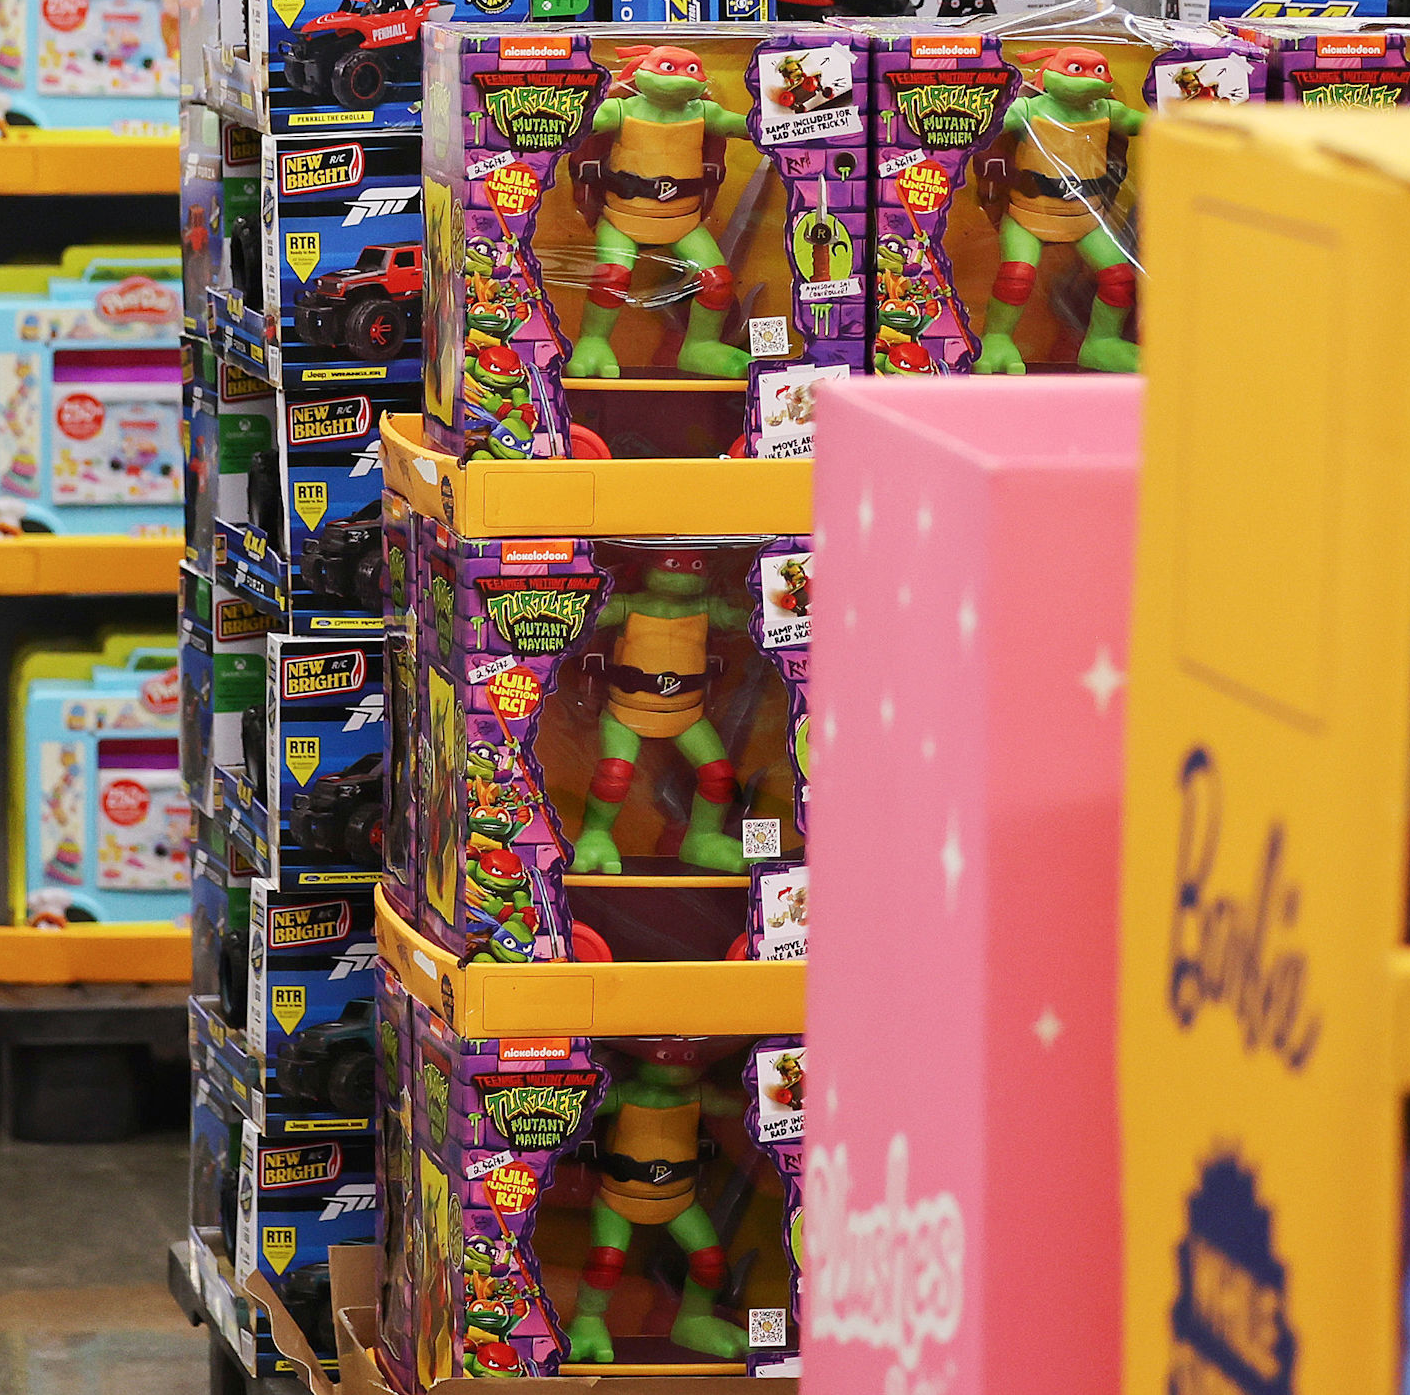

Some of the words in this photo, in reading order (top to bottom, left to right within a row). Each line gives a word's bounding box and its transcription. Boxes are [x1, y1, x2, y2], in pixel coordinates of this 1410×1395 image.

[504, 46, 566, 57] nickelodeon
[916, 45, 977, 56] nickelodeon
[1321, 44, 1381, 54] nickelodeon
[327, 114, 339, 123] THE
[340, 113, 365, 122] CHOLLA
[485, 86, 589, 137] TURTLES
[896, 85, 999, 136] TURTLES
[512, 116, 566, 134] MUTANT
[765, 122, 790, 135] RAMP
[793, 112, 833, 129] INCLUDED
[792, 123, 816, 137] SKATE
[923, 114, 977, 132] MUTANT
[516, 134, 562, 149] MAYHEM
[927, 131, 973, 146] MAYHEM
[285, 154, 323, 173] NEW
[329, 154, 346, 165] R/C
[286, 165, 349, 190] BRIGHT
[497, 192, 525, 213] RC!
[907, 191, 935, 211] RC!
[290, 236, 316, 250] RTR
[307, 371, 327, 379] Jeep
[293, 405, 330, 423] NEW
[336, 404, 353, 415] R/C
[294, 417, 356, 439] BRIGHT
[298, 485, 323, 499] RTR
[506, 550, 568, 561] nickelodeon
[487, 590, 591, 642] TURTLES
[513, 620, 568, 638] MUTANT
[518, 637, 564, 653] MAYHEM
[288, 659, 325, 678] NEW
[331, 659, 348, 670] R/C
[288, 671, 351, 694] BRIGHT
[498, 696, 527, 717] RC!
[289, 740, 316, 754] RTR
[274, 909, 312, 928] NEW
[274, 921, 337, 944] BRIGHT
[276, 989, 302, 1003] RTR
[503, 1046, 565, 1058] nickelodeon
[485, 1087, 587, 1138] TURTLES
[510, 1116, 565, 1134] MUTANT
[515, 1133, 561, 1148] MAYHEM
[264, 1150, 301, 1168] NEW
[265, 1162, 327, 1185] BRIGHT
[495, 1191, 523, 1212] RC!
[266, 1230, 292, 1244] RTR
